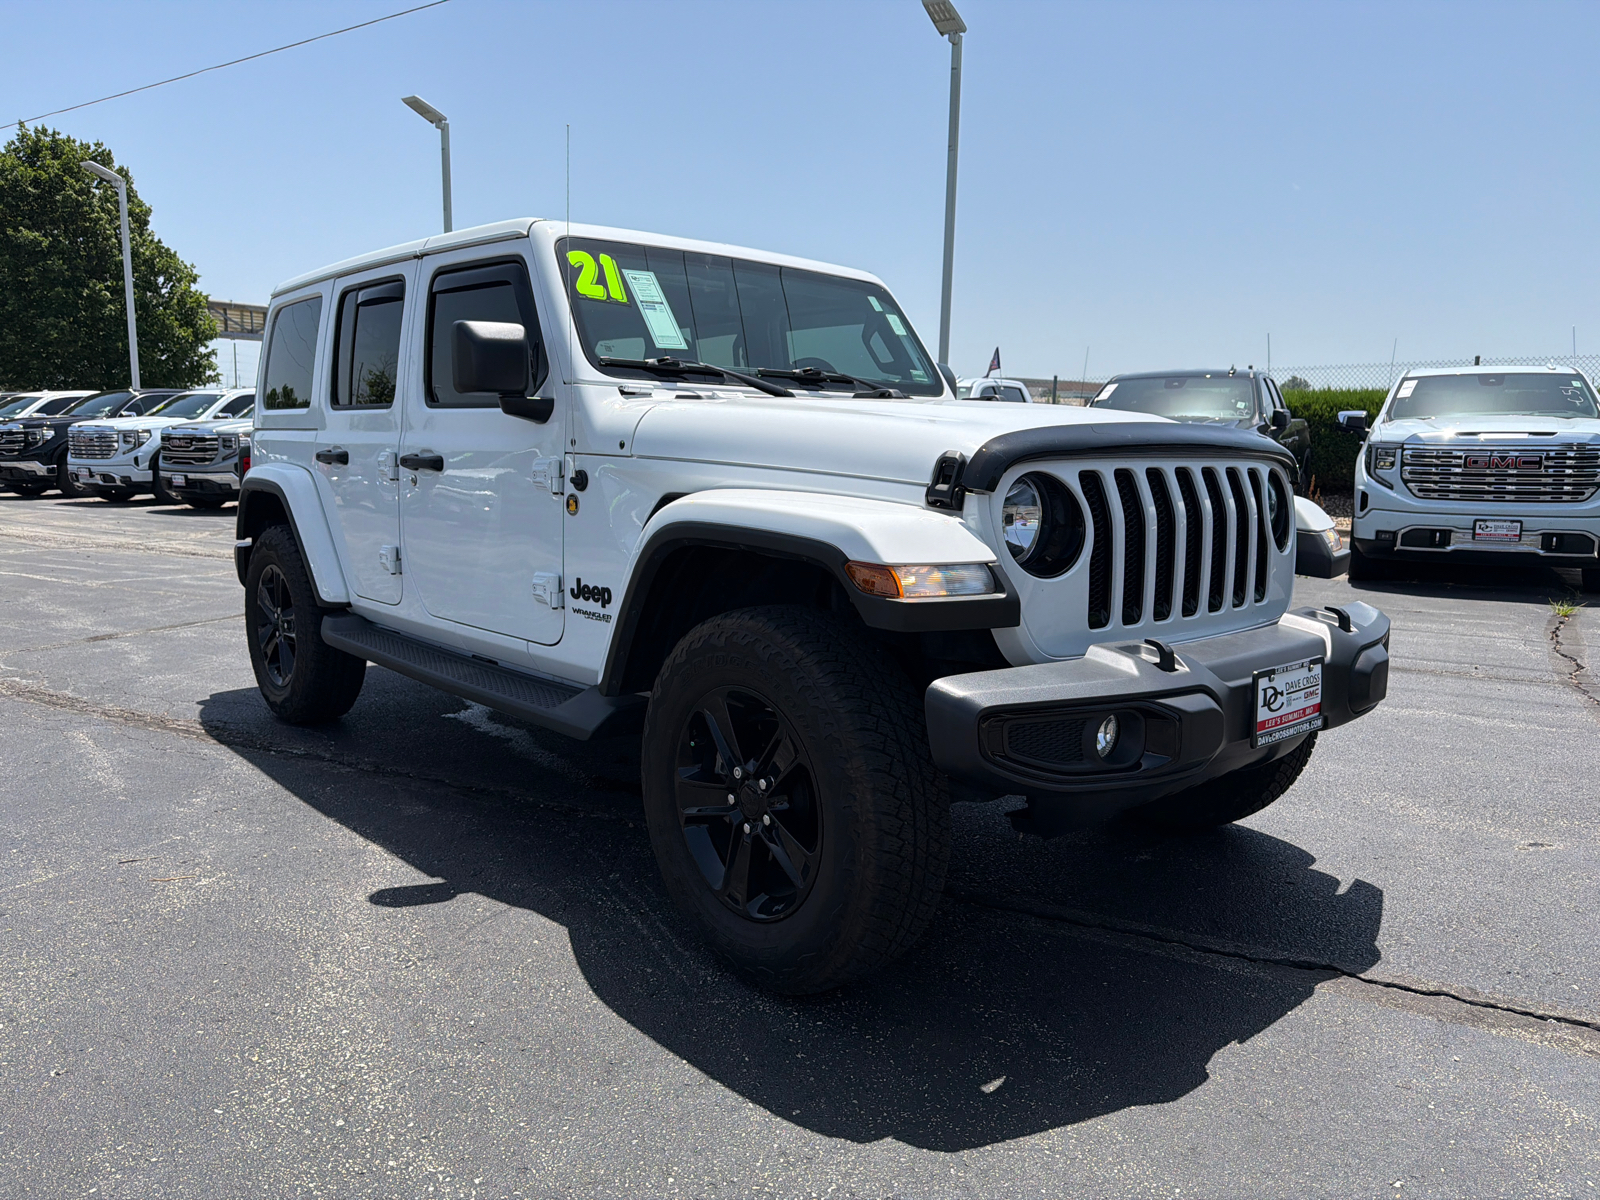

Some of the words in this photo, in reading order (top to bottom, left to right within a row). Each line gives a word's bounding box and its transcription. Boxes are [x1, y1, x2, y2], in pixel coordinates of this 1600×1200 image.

[566, 250, 627, 302] 21
[1467, 456, 1540, 469] GMC
[570, 577, 612, 608] Jeep
[572, 607, 612, 620] WRANGLER
[1285, 680, 1301, 691] DAVE
[1302, 673, 1320, 687] CROSS
[1303, 688, 1319, 698] GMC
[1265, 717, 1281, 728] LEE'S
[1305, 706, 1314, 715] MO
